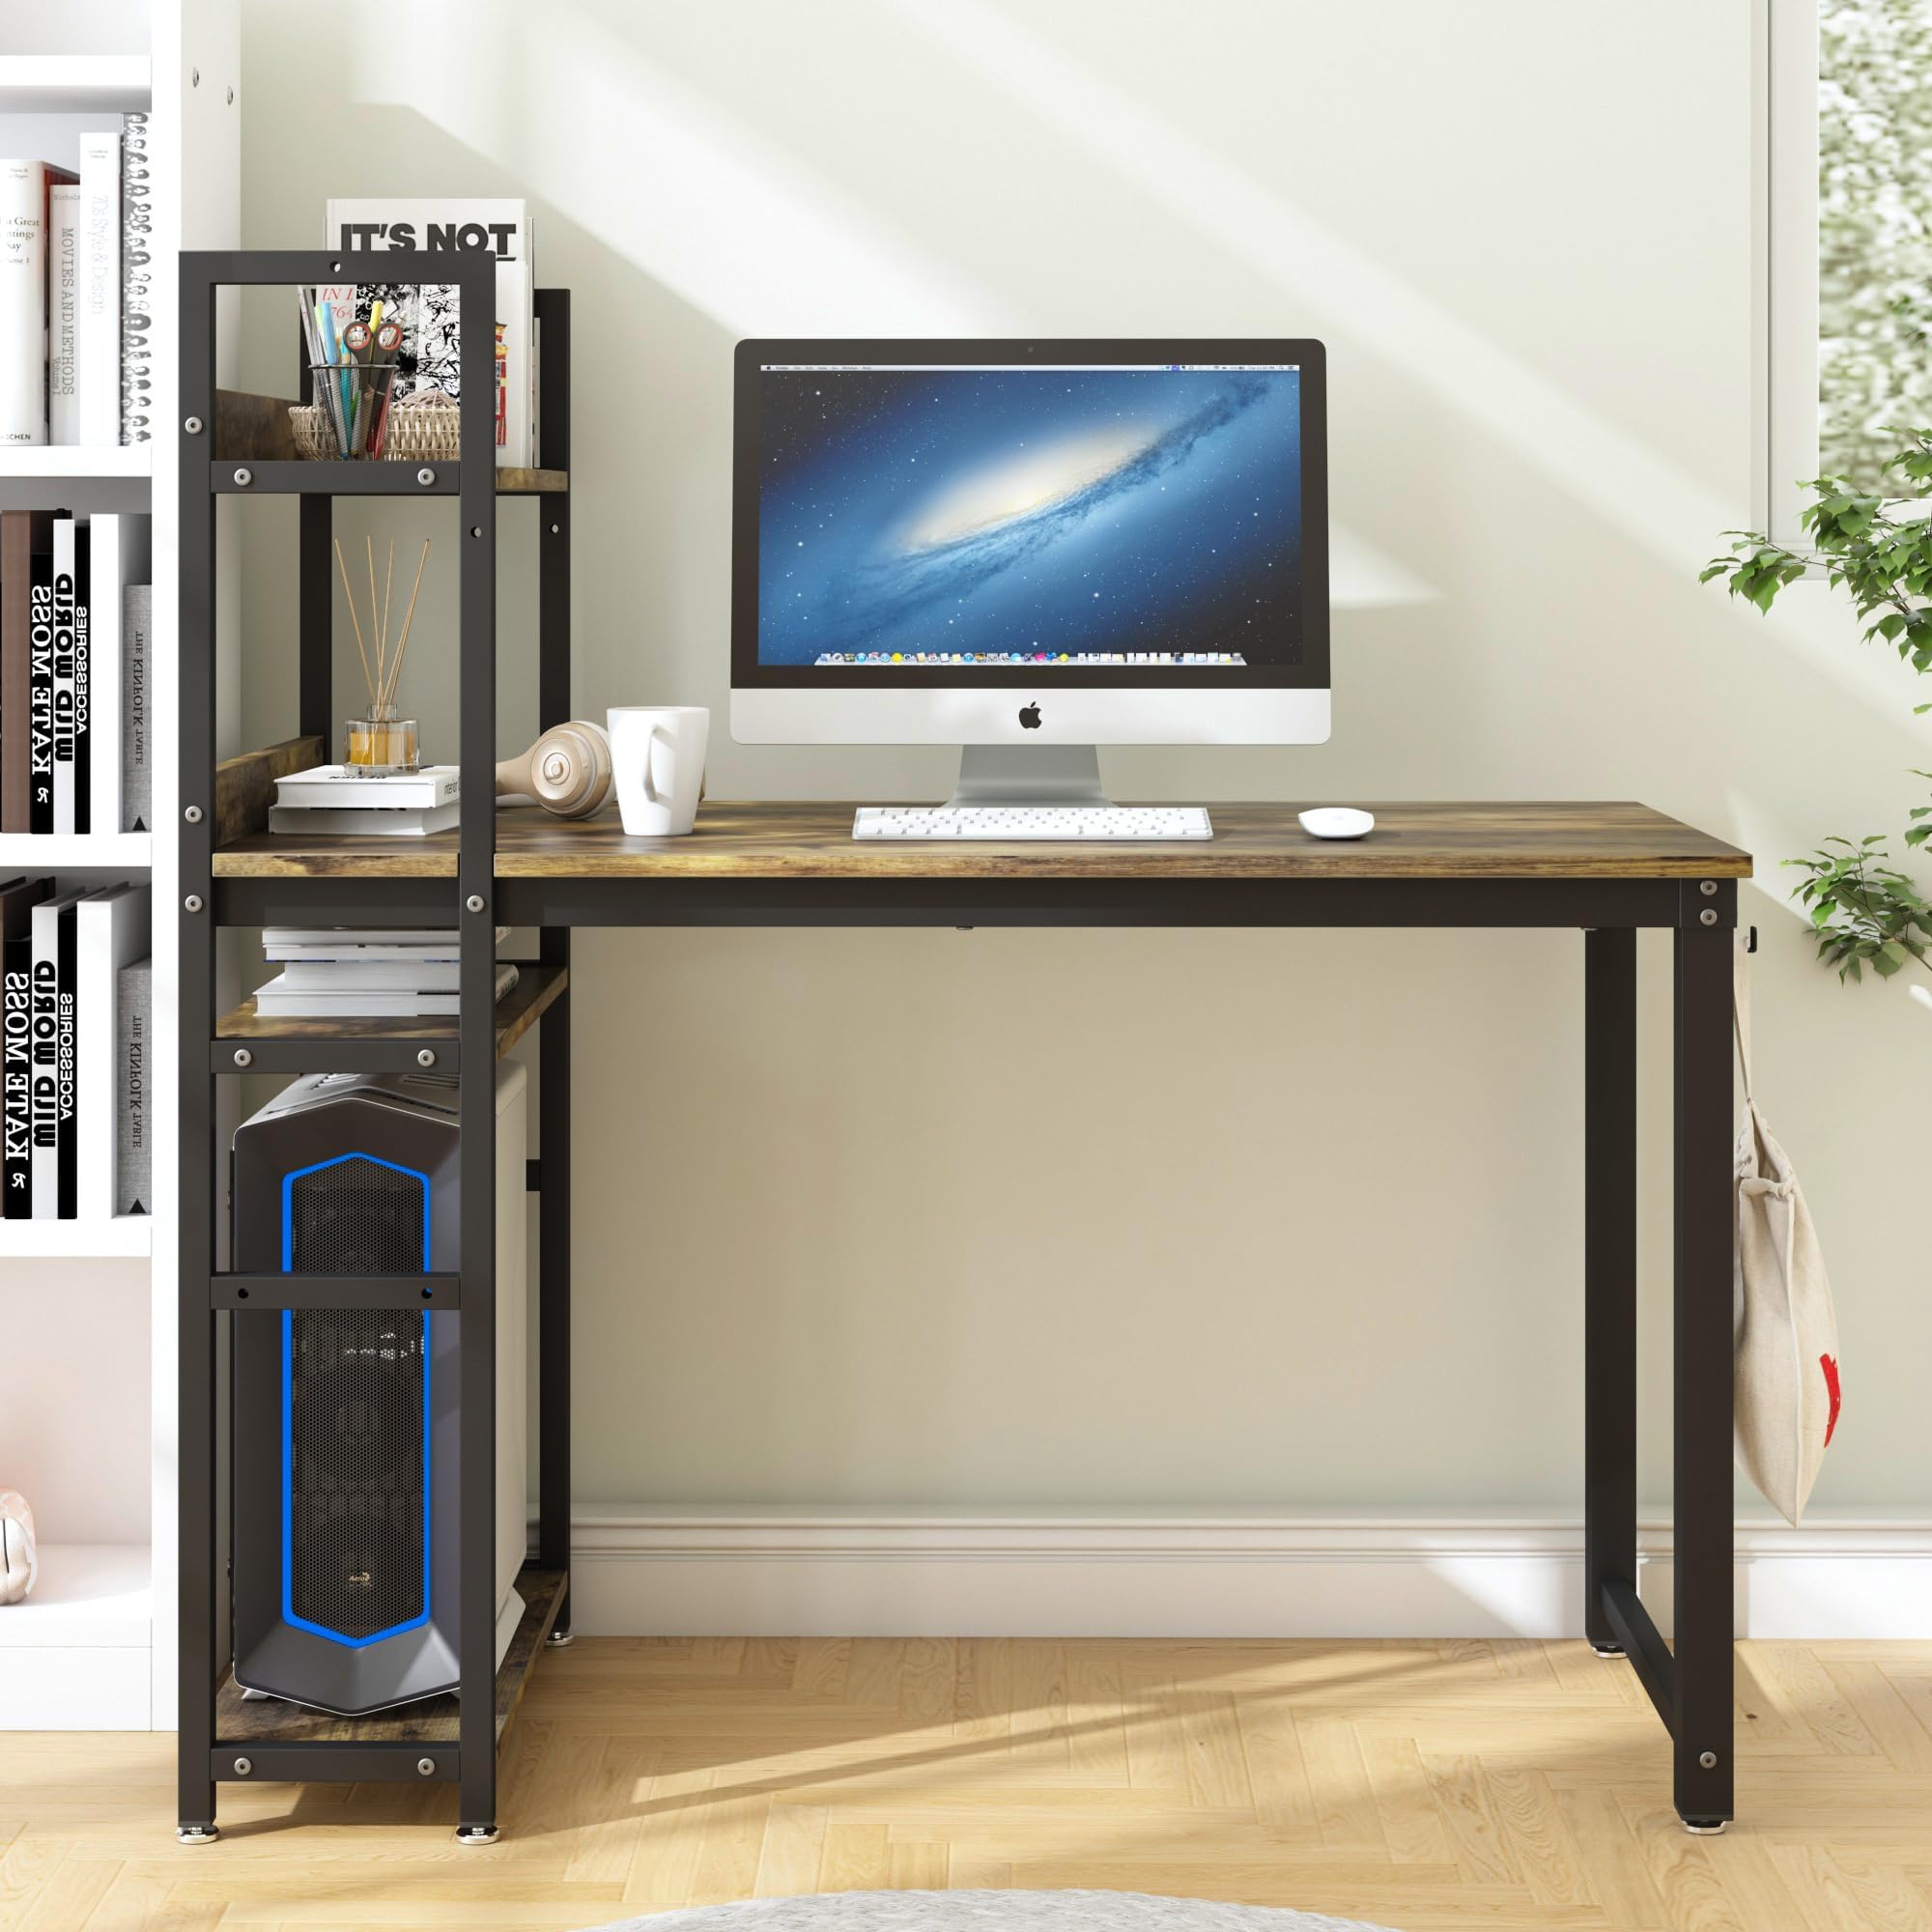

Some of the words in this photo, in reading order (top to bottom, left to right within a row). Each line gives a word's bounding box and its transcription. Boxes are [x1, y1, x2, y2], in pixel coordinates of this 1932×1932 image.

[14, 216, 40, 226] Great
[341, 223, 416, 251] IT'S
[427, 223, 517, 255] NOT
[61, 227, 74, 288] MOVIES
[61, 290, 74, 323] AND
[61, 325, 74, 396] METHODS
